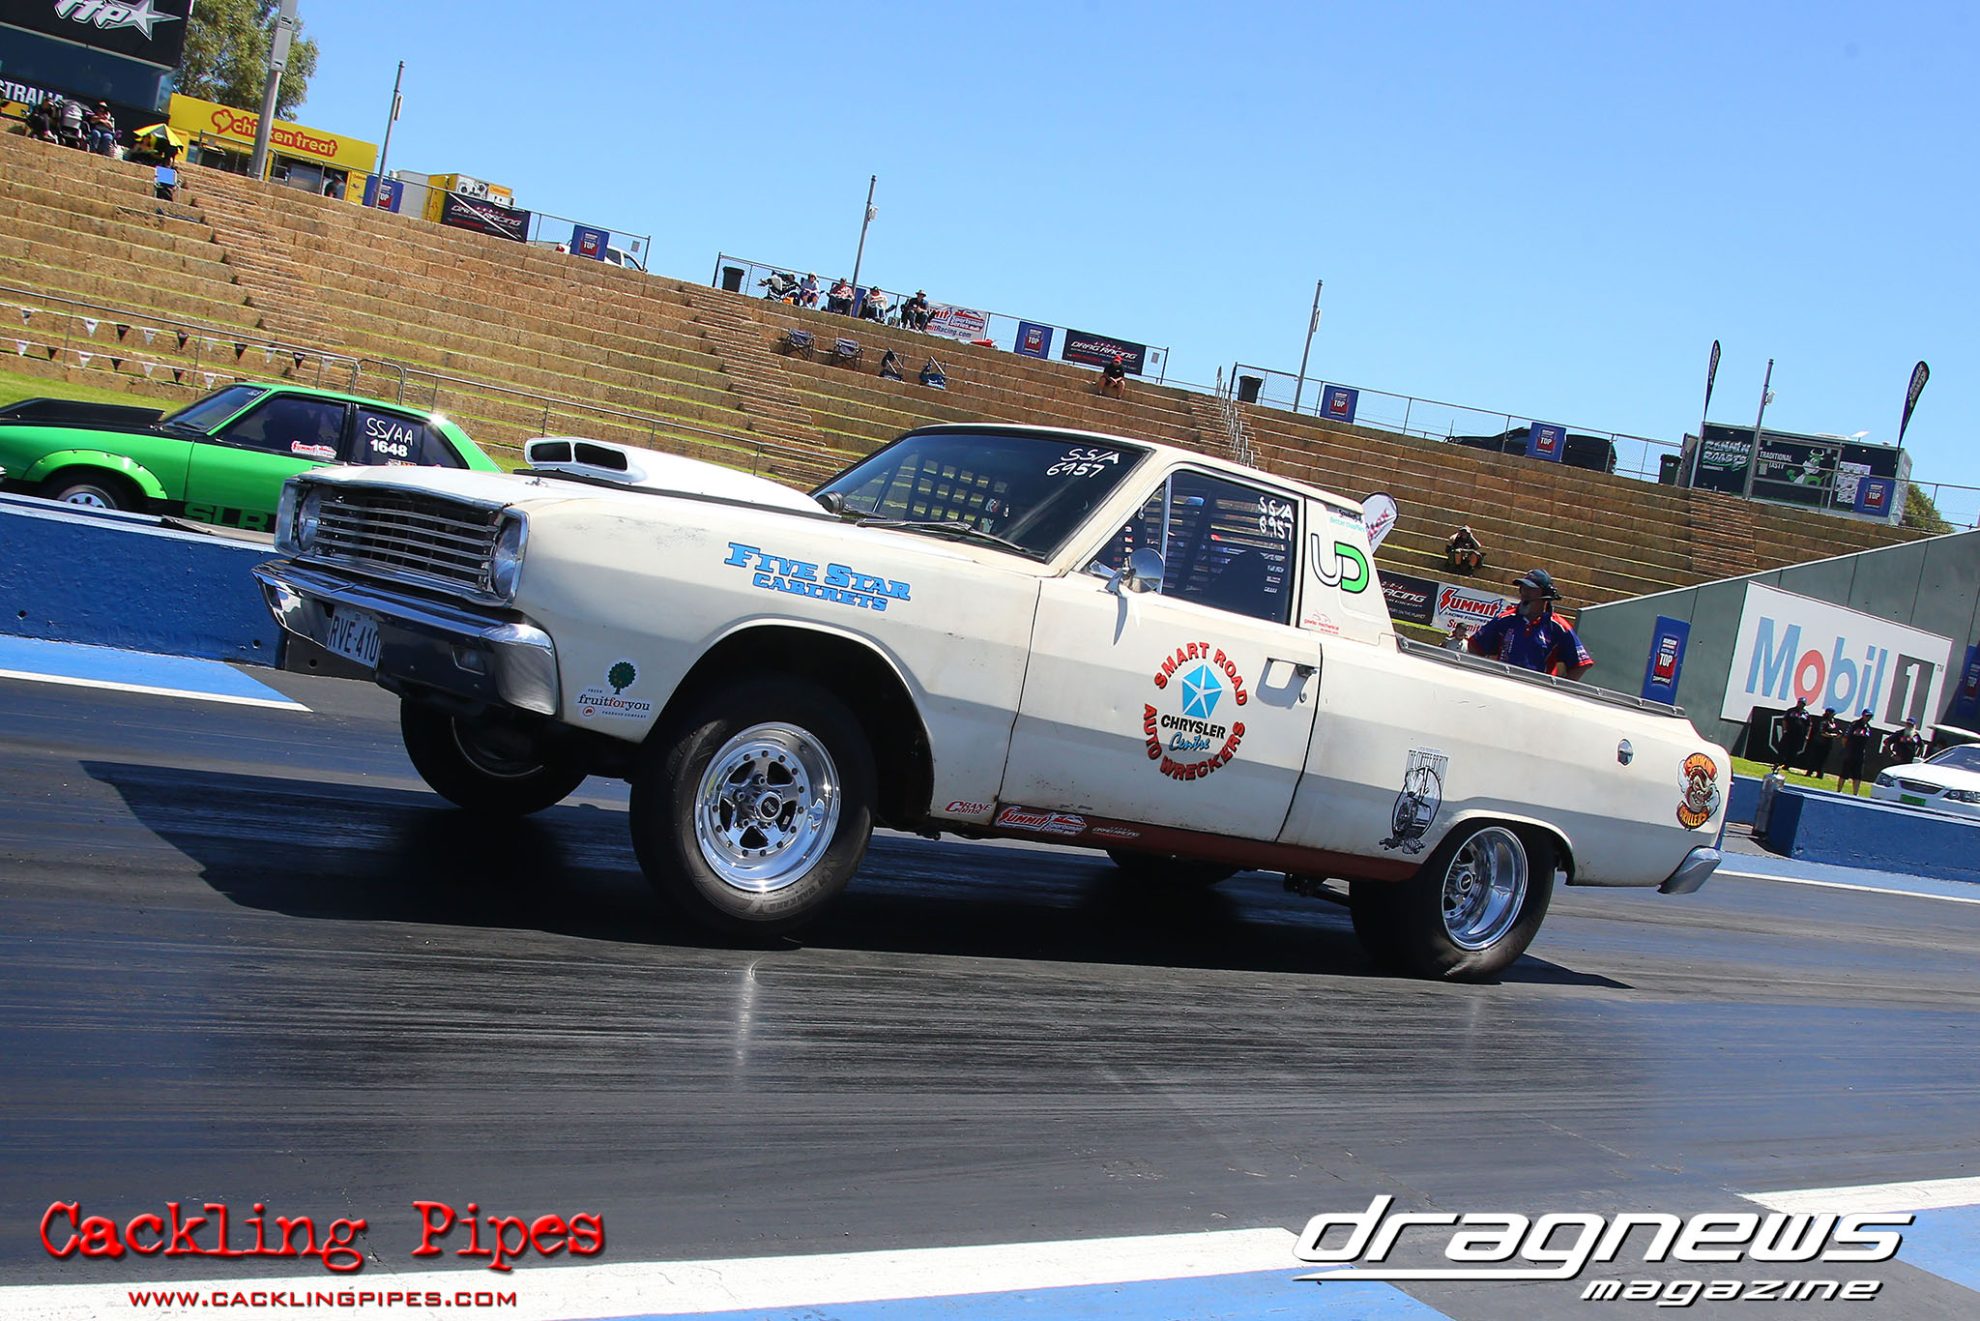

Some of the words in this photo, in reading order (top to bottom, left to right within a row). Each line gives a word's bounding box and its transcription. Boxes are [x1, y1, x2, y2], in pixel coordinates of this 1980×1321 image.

[295, 134, 335, 154] treat
[584, 241, 596, 250] TOP
[1070, 340, 1100, 351] DRAG
[1100, 345, 1138, 360] RACING
[1334, 400, 1346, 408] TOP
[366, 417, 414, 446] SS/AA
[370, 439, 408, 457] 1648
[1541, 437, 1553, 446] TOP
[1061, 448, 1120, 465] SS/A
[1046, 462, 1105, 478] 6957
[1868, 492, 1881, 500] TOP
[724, 542, 819, 582] FIVE
[824, 563, 911, 601] STAR
[752, 573, 888, 612] CABINETS
[1382, 588, 1427, 603] ACING
[1659, 653, 1673, 668] TOP
[1745, 616, 1888, 720] Mobil
[1154, 641, 1210, 689] SMART
[1213, 648, 1248, 706] ROAD
[577, 694, 650, 711] fruitforyou
[1160, 715, 1226, 739] CHRYSLER
[1143, 703, 1162, 760] AUTO
[1160, 721, 1246, 781] WRECKERS
[1168, 731, 1211, 752] Centre
